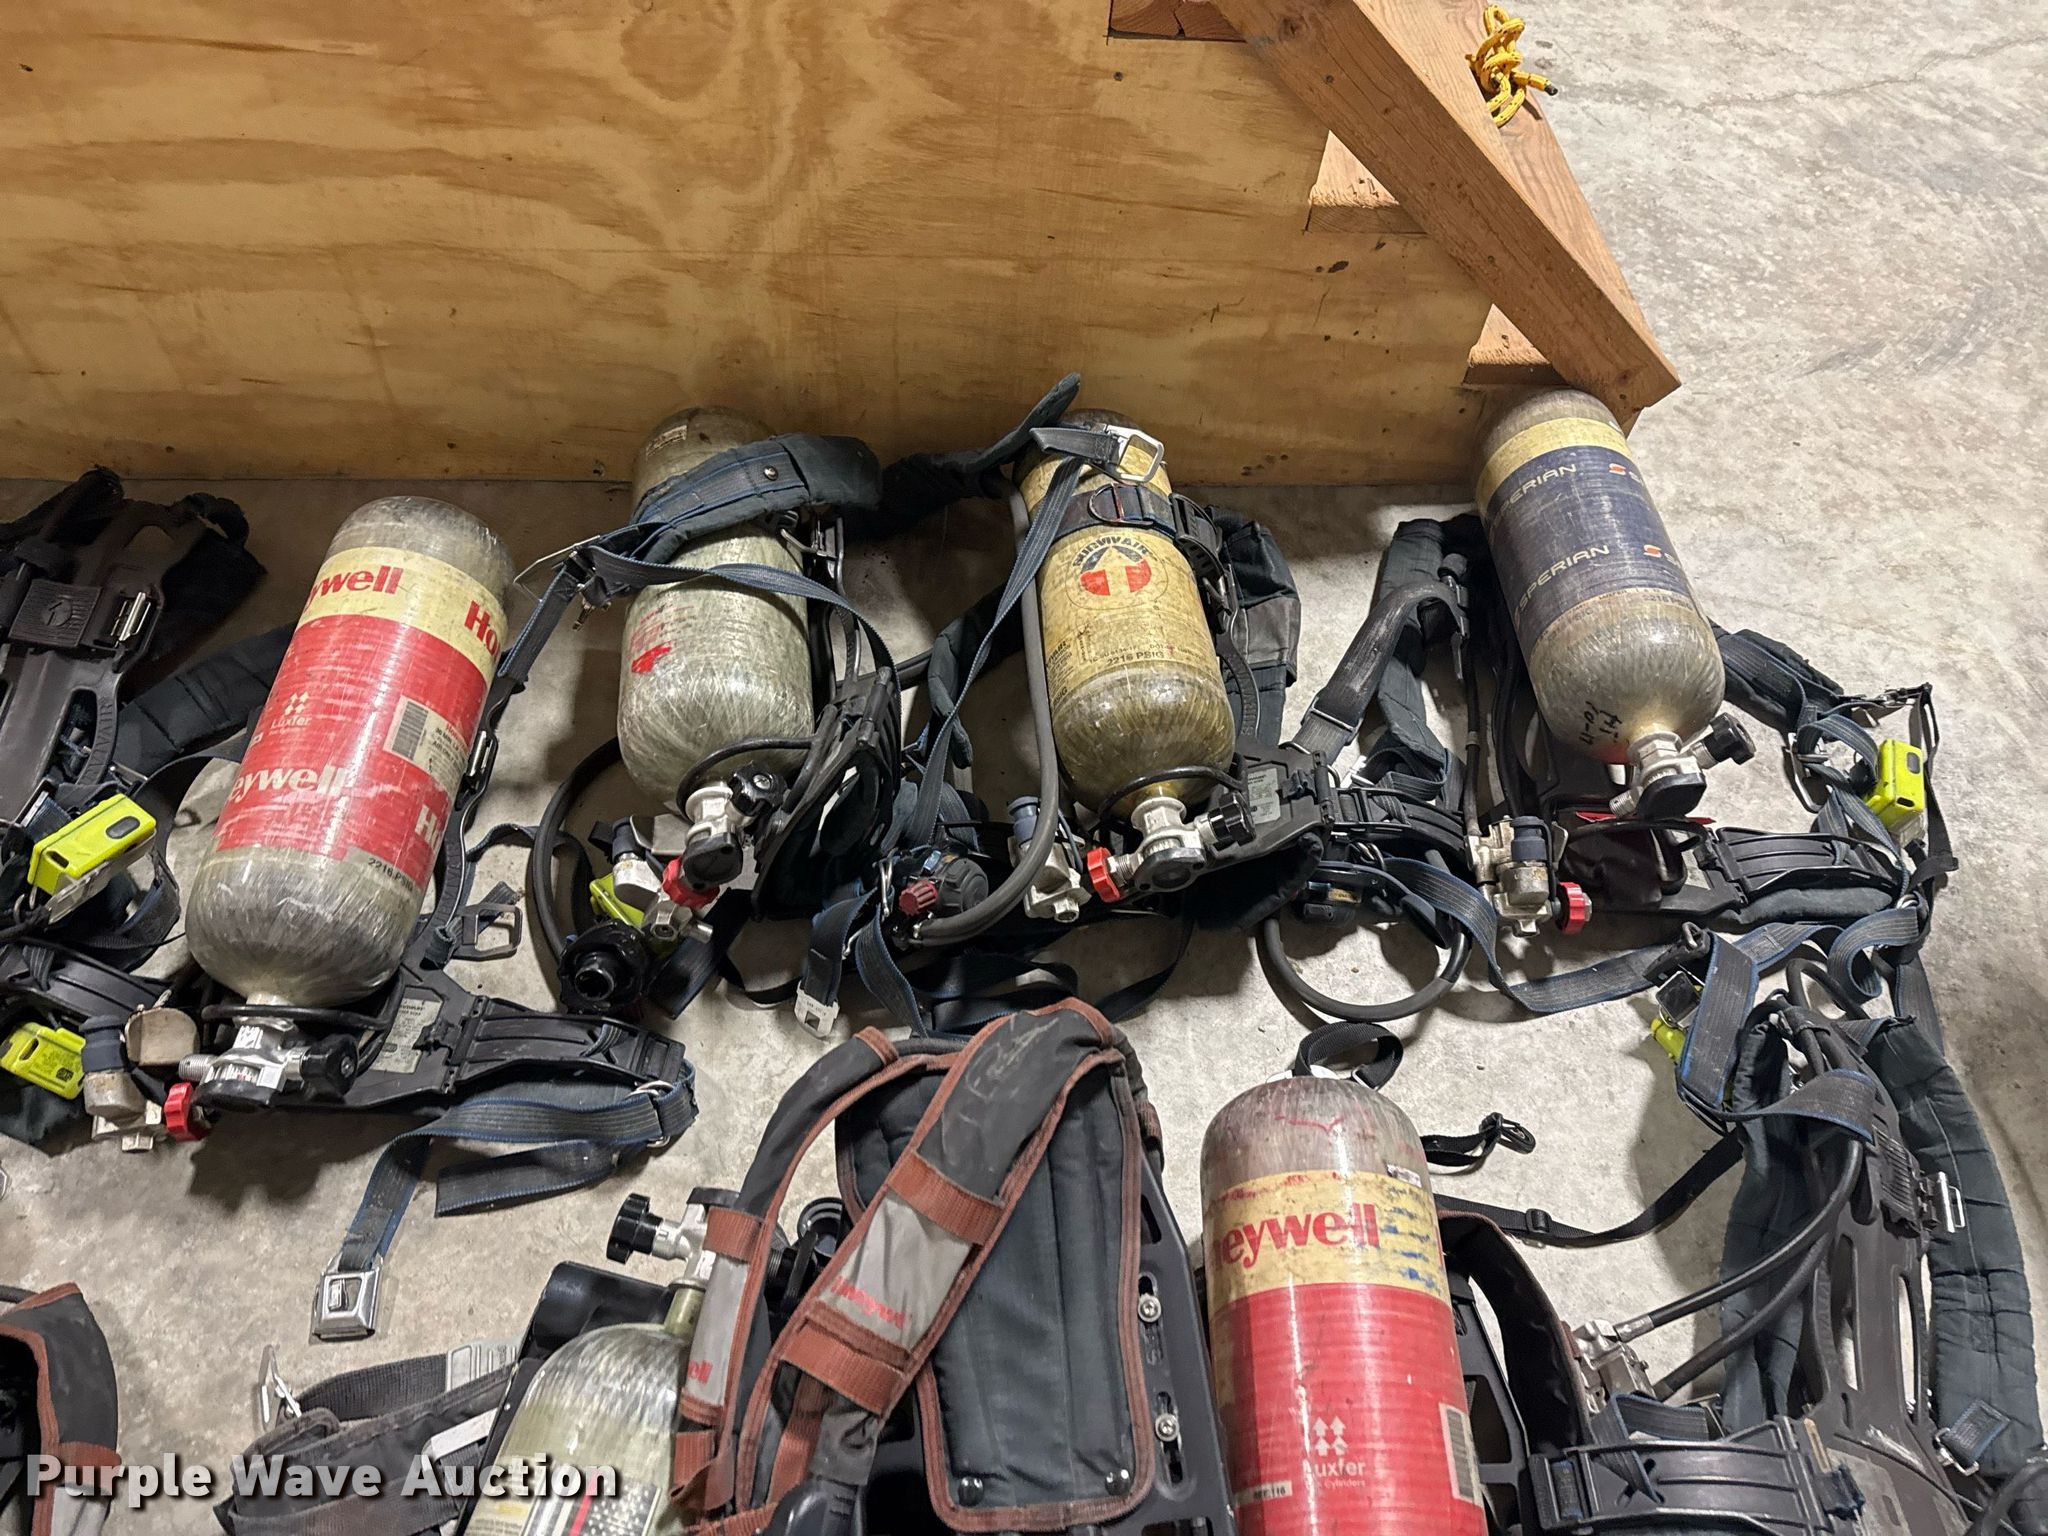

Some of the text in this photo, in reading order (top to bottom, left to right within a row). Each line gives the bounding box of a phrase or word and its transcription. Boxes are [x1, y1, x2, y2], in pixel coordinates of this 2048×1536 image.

[1072, 536, 1150, 567] SURVIVAIR
[1519, 544, 1610, 612] SPERIAN
[1107, 654, 1134, 667] 2216
[1136, 651, 1165, 660] PSIG
[367, 857, 394, 878] 2216
